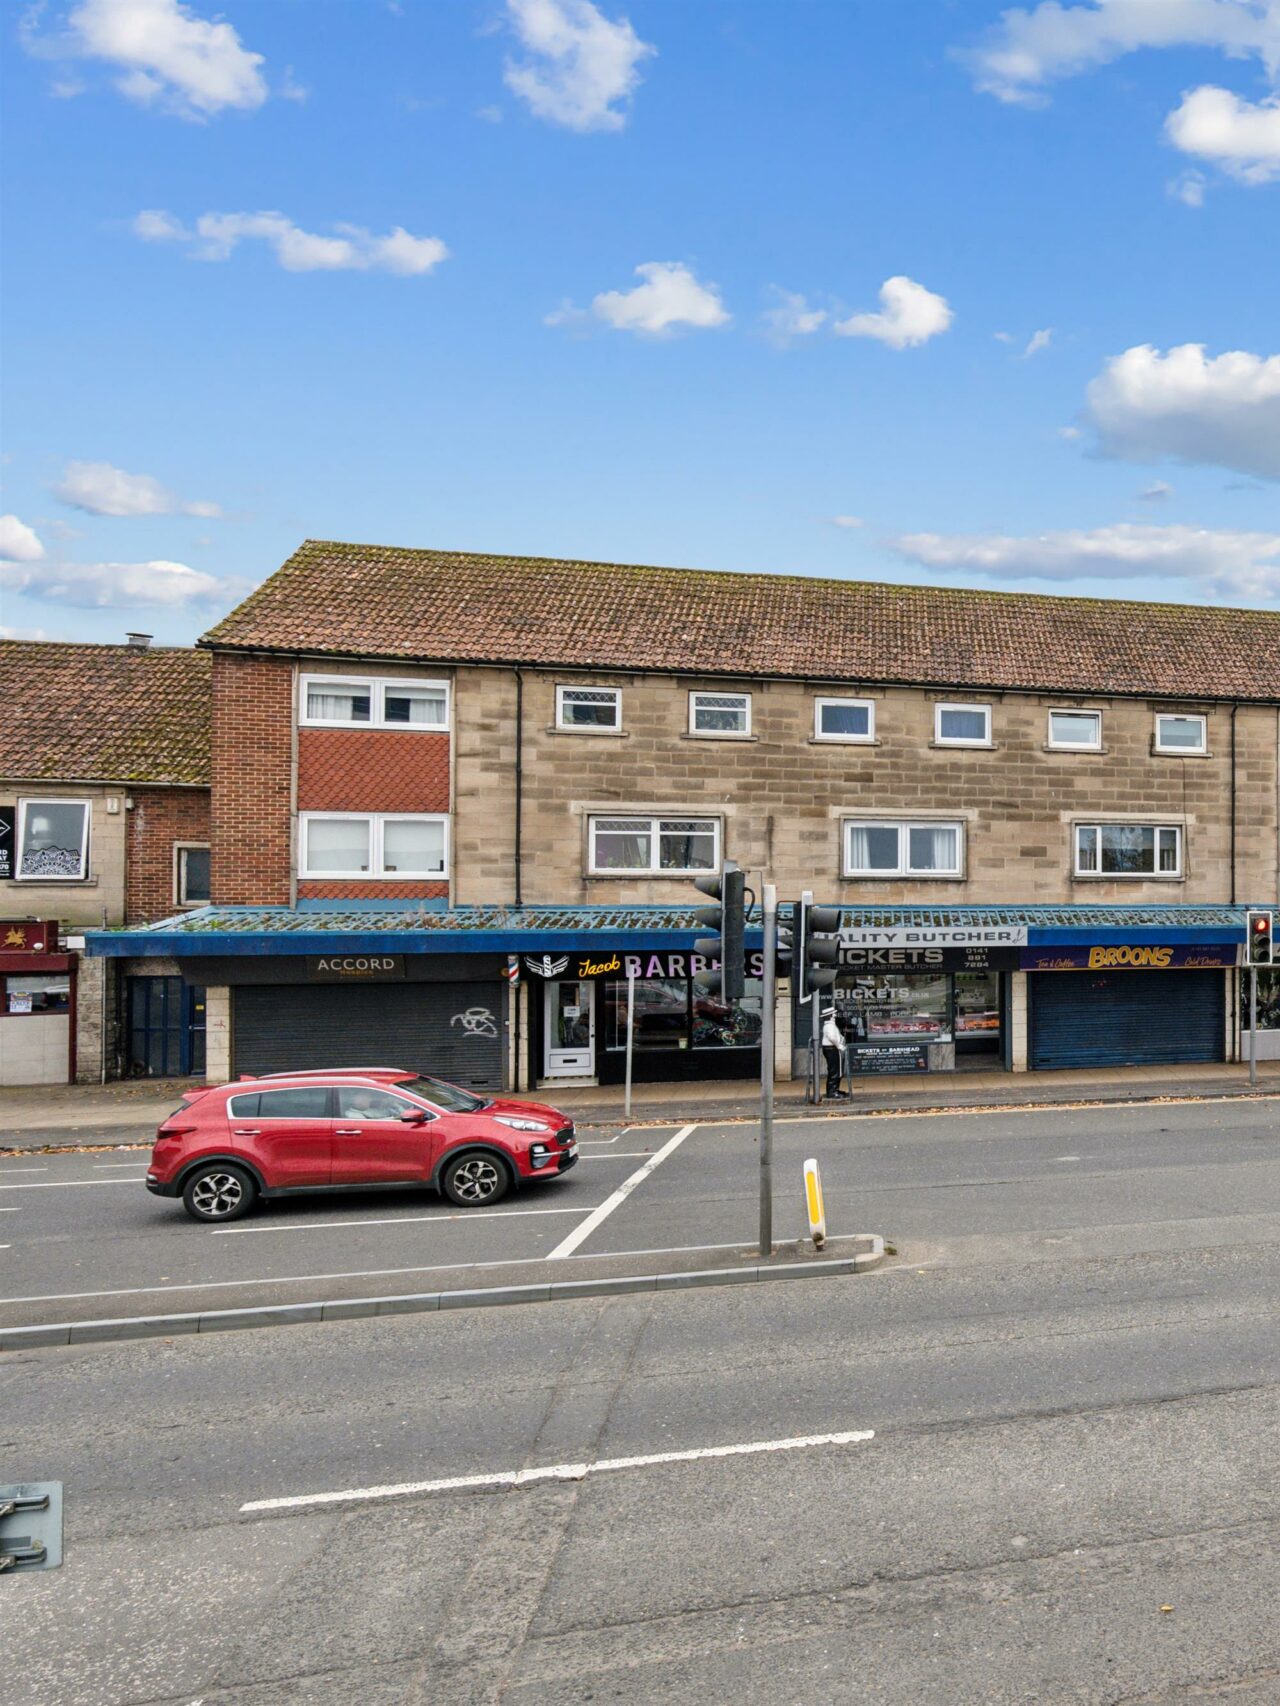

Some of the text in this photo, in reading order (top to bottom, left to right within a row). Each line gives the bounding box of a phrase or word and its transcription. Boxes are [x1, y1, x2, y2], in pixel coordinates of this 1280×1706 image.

[817, 931, 1011, 943] ALITY BUTCHER
[317, 958, 395, 970] ACCORD
[838, 948, 944, 964] ICKETS
[1088, 945, 1174, 968] BROONS
[578, 954, 764, 978] Jacob BARBS
